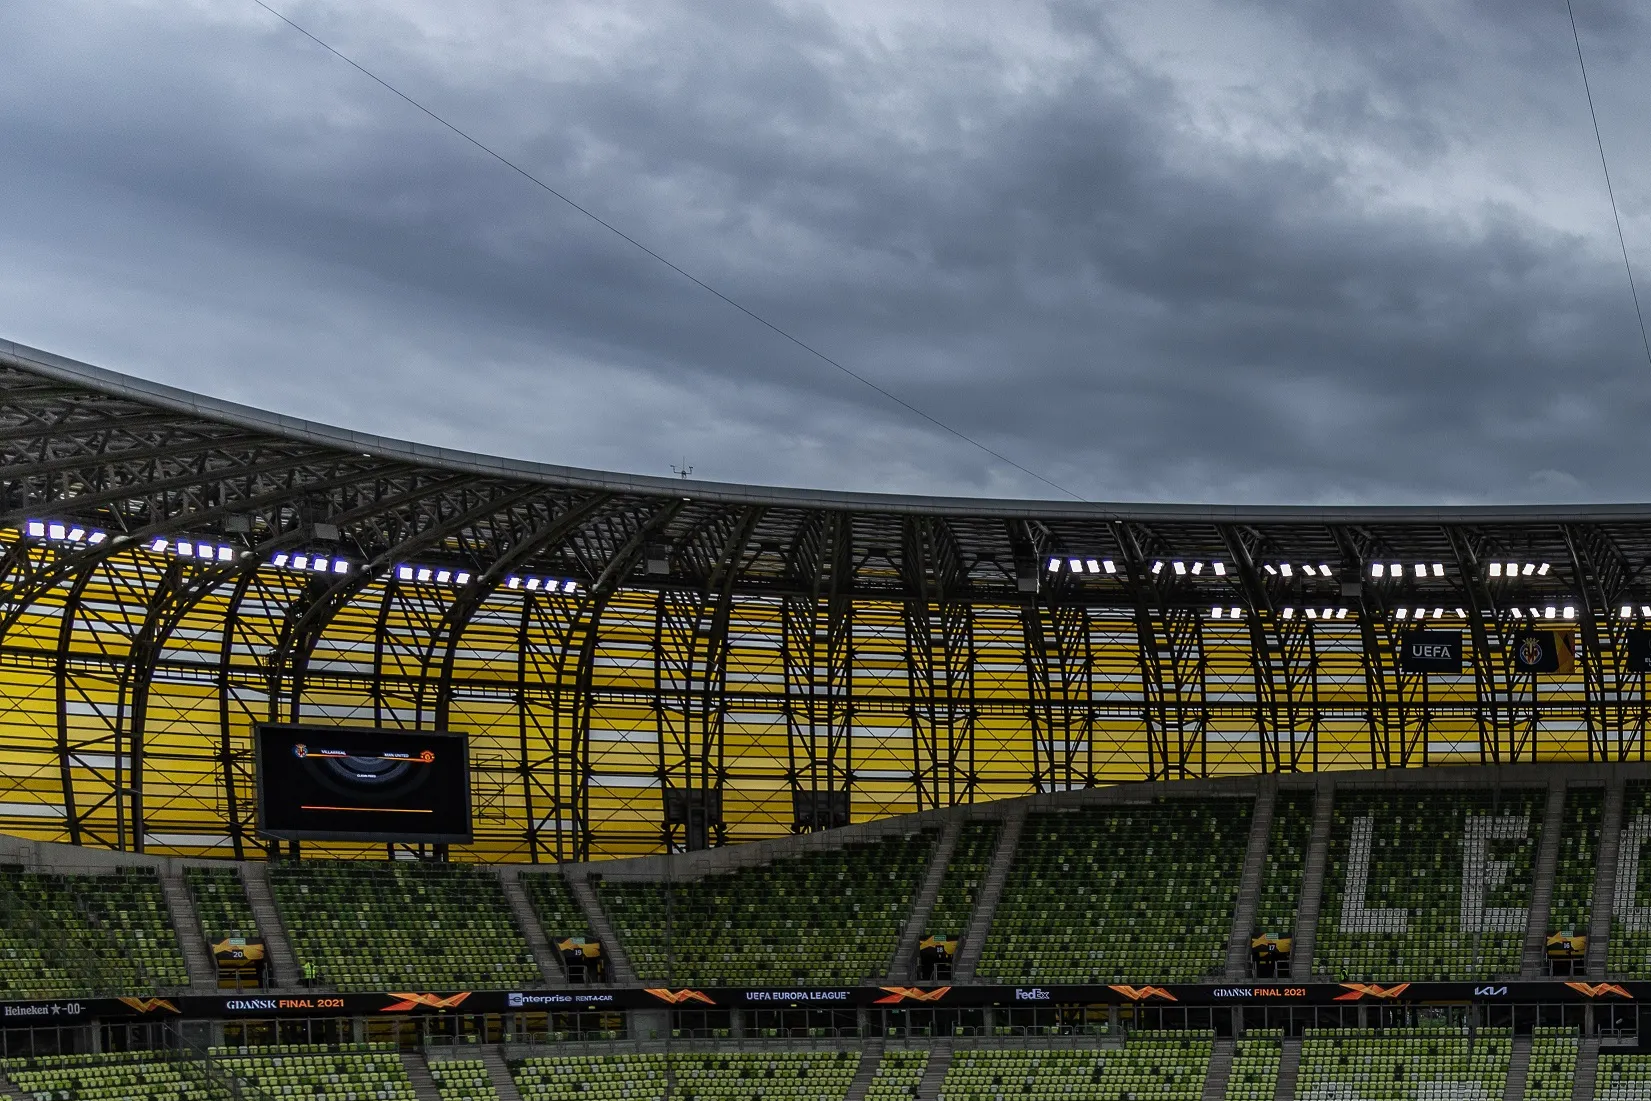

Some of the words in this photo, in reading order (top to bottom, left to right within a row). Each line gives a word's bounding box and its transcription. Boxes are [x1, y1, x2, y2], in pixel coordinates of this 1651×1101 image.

[1412, 645, 1451, 658] UEFA
[746, 992, 771, 1000] UEFA
[773, 992, 809, 1000] EUROPA
[1015, 988, 1049, 1000] FedEx
[1213, 988, 1253, 997] GDAŃSK
[1254, 988, 1282, 996] FINAL
[1284, 988, 1306, 996] 2021
[227, 1000, 277, 1011] GDAŃSK
[279, 999, 314, 1009] FINAL
[318, 998, 344, 1008] 2021
[509, 993, 572, 1006] enterprise
[575, 994, 613, 1002] RENT-A-CAR
[5, 1004, 49, 1016] Heineken
